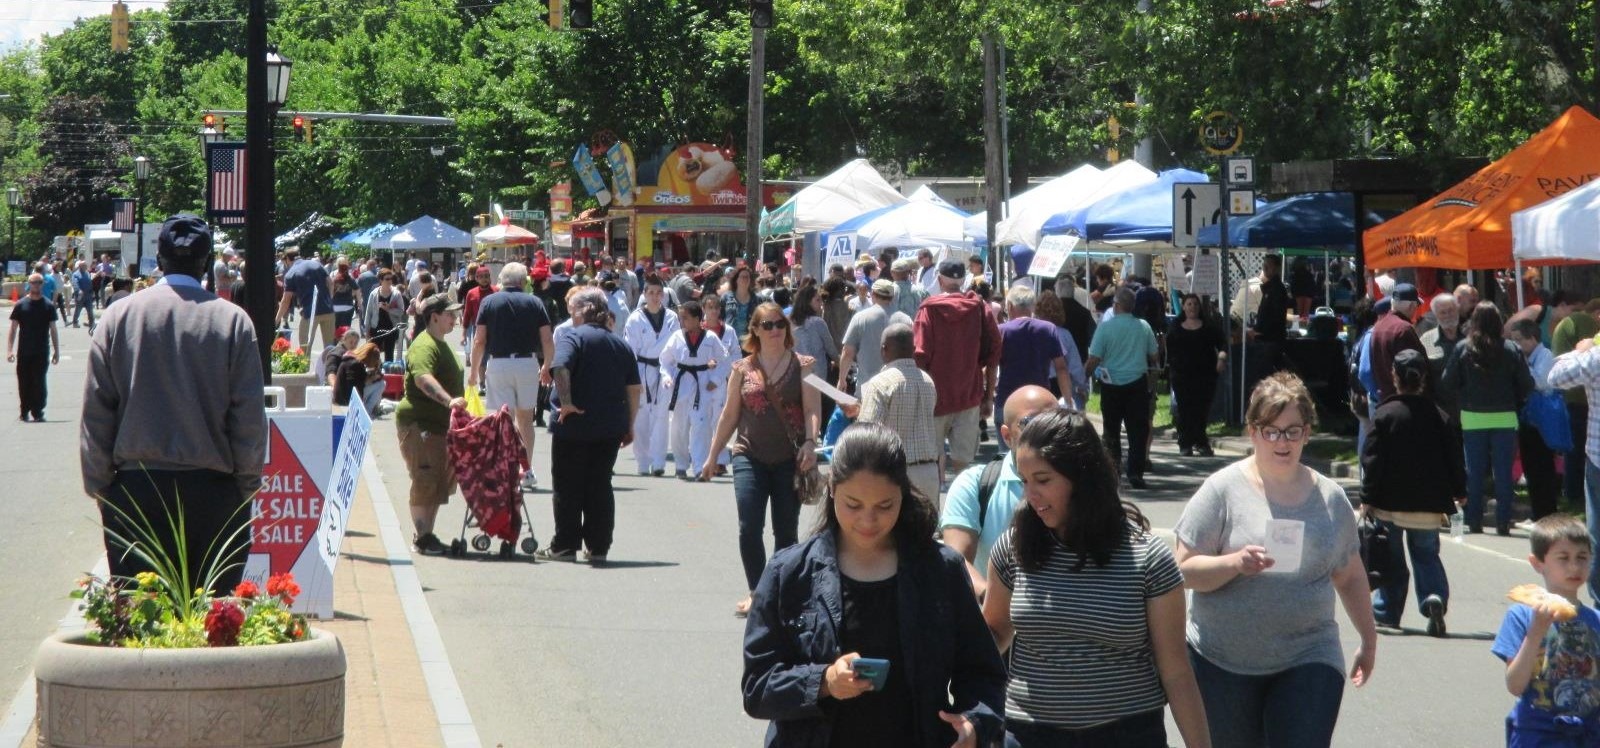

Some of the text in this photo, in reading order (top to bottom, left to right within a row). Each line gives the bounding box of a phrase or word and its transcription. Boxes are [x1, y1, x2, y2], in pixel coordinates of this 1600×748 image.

[261, 475, 303, 493] SALE
[337, 451, 354, 510] Bike
[270, 498, 320, 519] SALE
[261, 525, 303, 544] SALE
